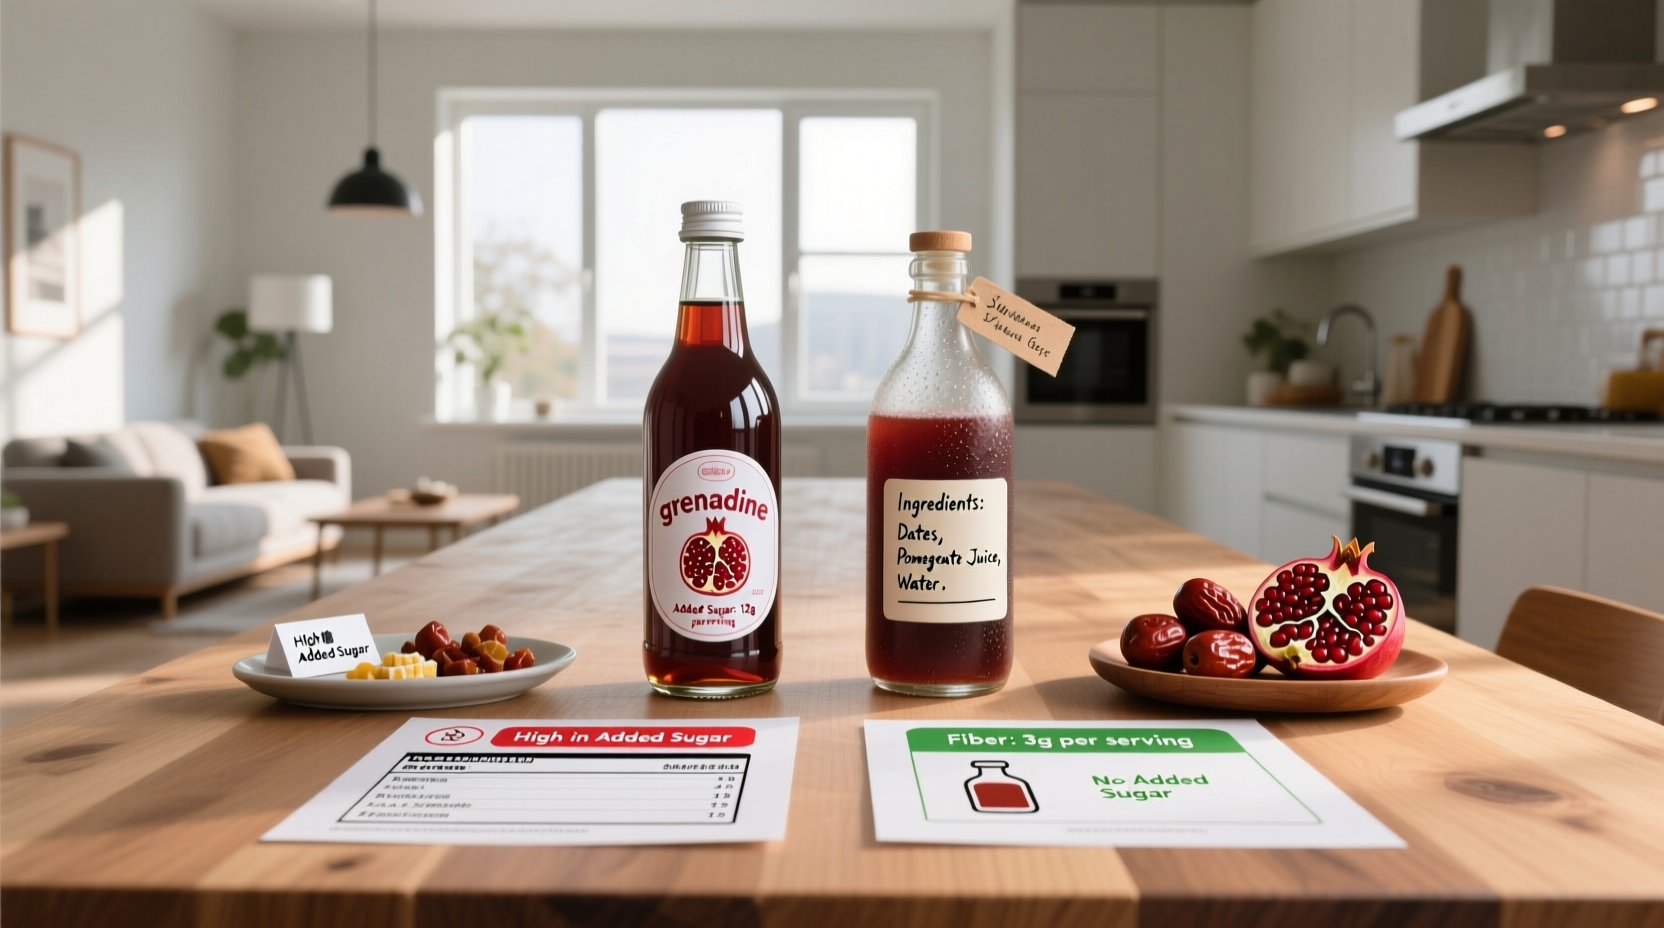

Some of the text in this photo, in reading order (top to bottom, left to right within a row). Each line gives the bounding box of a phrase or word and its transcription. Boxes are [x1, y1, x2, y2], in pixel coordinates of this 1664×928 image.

[660, 488, 768, 527] grenadine
[898, 492, 984, 518] Ingredients:
[898, 523, 943, 545] Dates,
[966, 548, 1001, 566] Juice,
[898, 573, 946, 591] Water.
[299, 645, 370, 664] Added Sugar
[513, 731, 732, 745] High in Added Sugar
[947, 733, 1194, 749] Fiber: 3g per serving
[1091, 774, 1209, 786] No Added
[1099, 788, 1172, 801] Sugar
